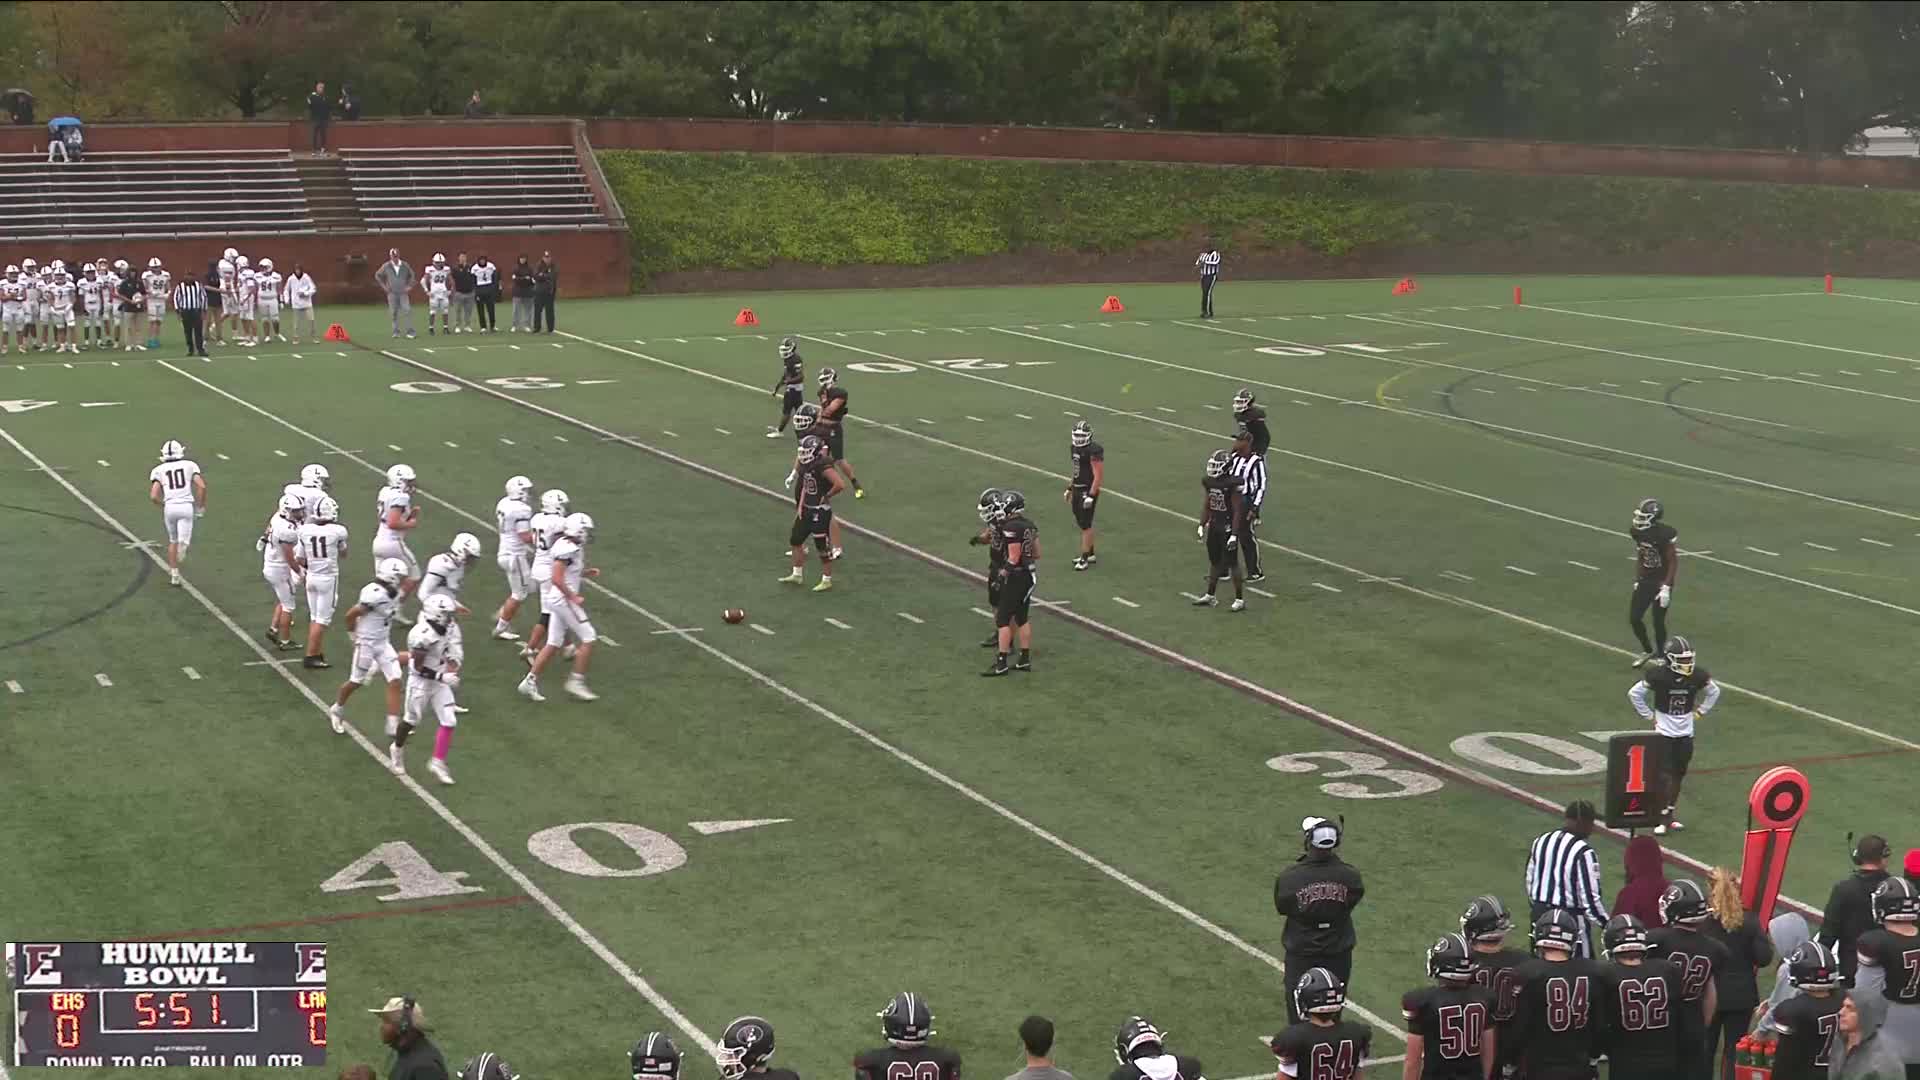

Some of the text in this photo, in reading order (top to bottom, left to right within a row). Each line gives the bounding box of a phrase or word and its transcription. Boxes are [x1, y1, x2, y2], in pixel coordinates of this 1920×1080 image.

[165, 468, 187, 490] 10
[310, 536, 328, 558] 11
[1626, 745, 1646, 792] 1
[1546, 976, 1590, 1032] 84
[1619, 976, 1669, 1031] 62
[1438, 1002, 1486, 1060] 50
[1310, 1039, 1354, 1080] 64
